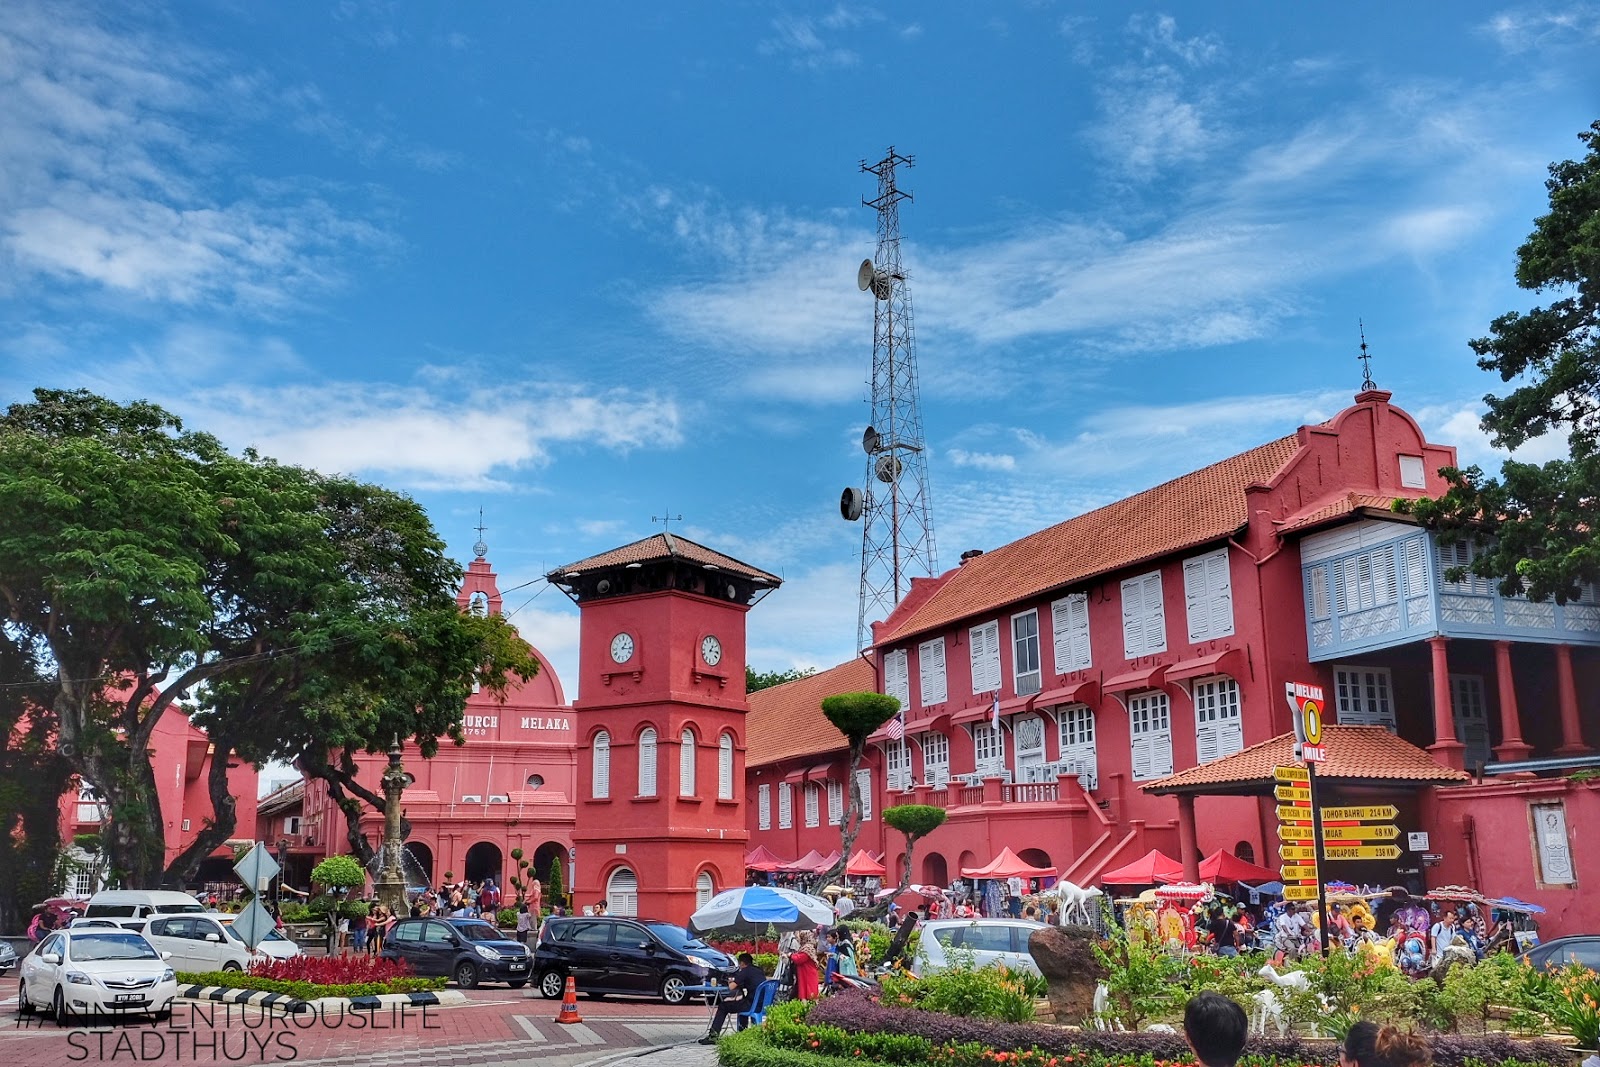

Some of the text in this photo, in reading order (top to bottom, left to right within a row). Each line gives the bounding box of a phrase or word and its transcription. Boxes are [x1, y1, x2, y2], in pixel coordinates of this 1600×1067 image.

[1296, 683, 1324, 701] MELAKA
[460, 715, 570, 730] HURCH MELAKA
[463, 728, 486, 736] 1753
[1304, 746, 1326, 761] MILE
[1323, 808, 1392, 818] JOHOR BAHRU 214 KM
[1325, 828, 1393, 838] MUAR 48 KM
[1326, 848, 1395, 857] SINGAPORE 238 KM
